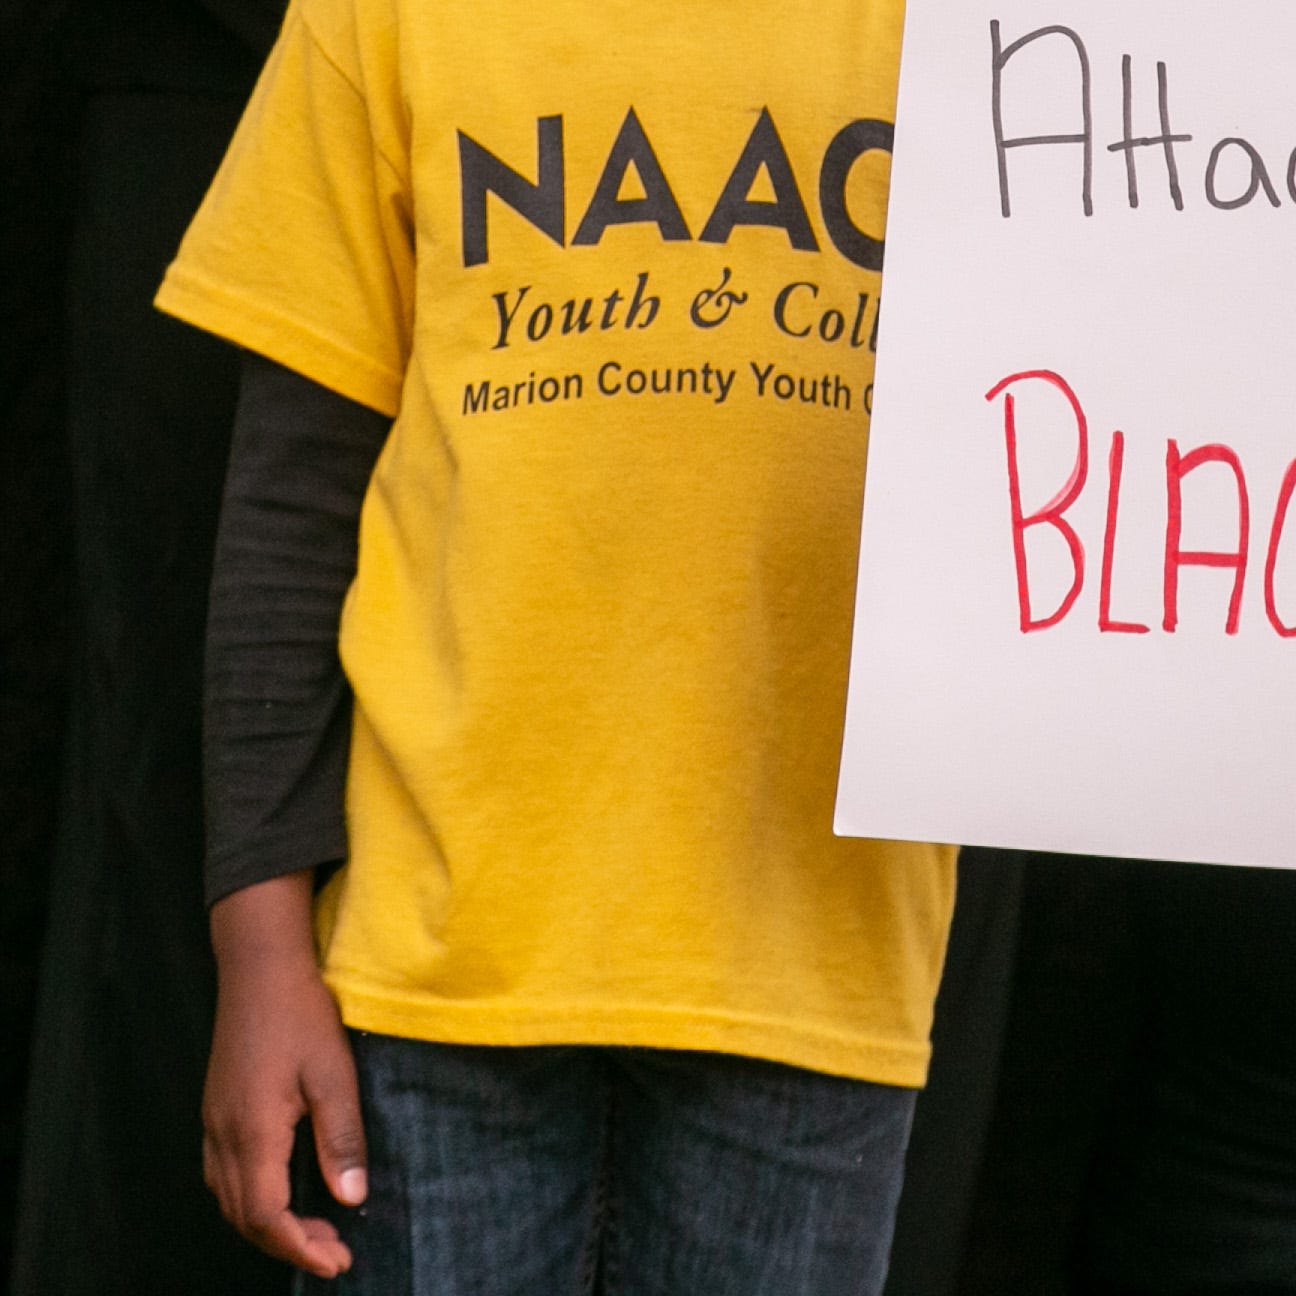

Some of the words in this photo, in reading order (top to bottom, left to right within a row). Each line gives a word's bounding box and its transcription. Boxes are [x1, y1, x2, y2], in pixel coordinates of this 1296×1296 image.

[491, 272, 661, 350] Youth
[689, 267, 748, 328] &
[462, 373, 584, 416] Marion
[597, 362, 736, 408] County
[749, 362, 851, 411] Youth
